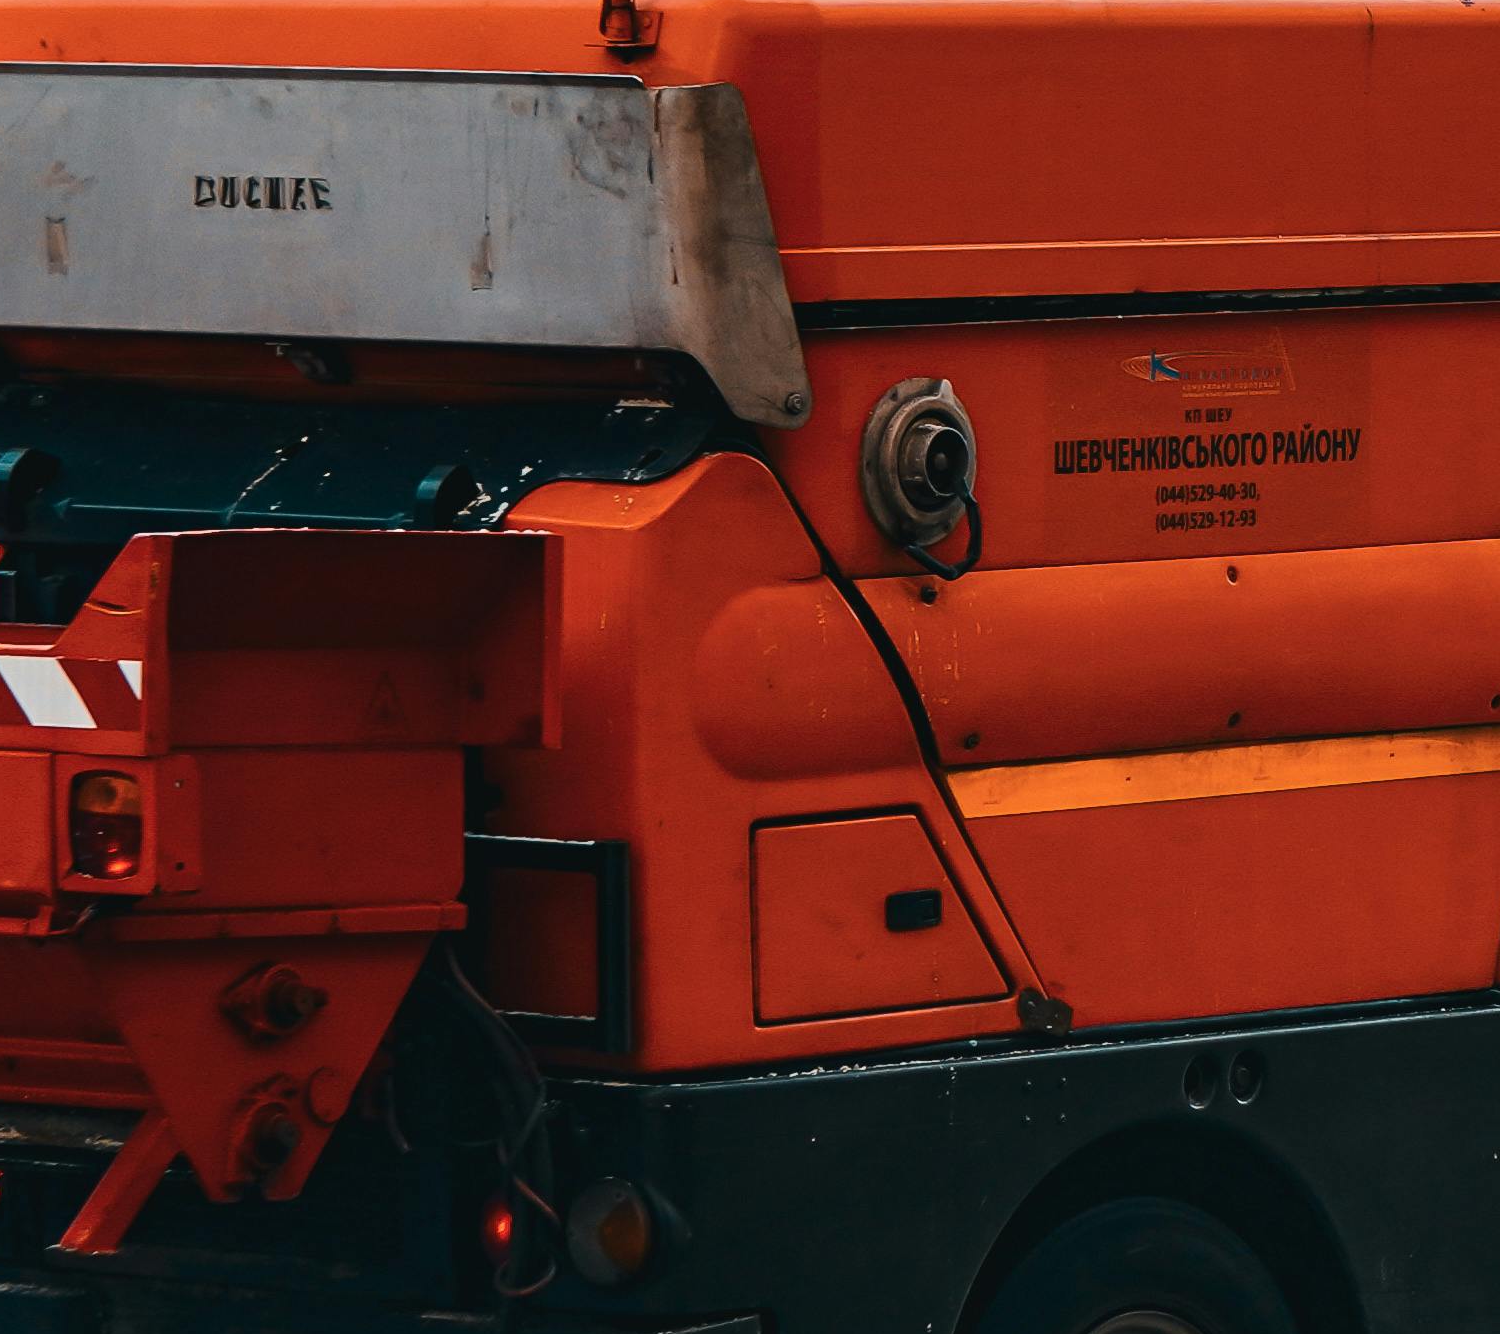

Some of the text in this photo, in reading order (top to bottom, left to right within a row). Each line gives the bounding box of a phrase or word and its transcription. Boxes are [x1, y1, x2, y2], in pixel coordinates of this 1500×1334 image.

[1184, 407, 1232, 423] КП ШЕУ
[1054, 423, 1361, 475] ШЕВЧЕНКІВСЬКОГО РАЙОНУ
[1155, 508, 1257, 533] (044)529-12-93
